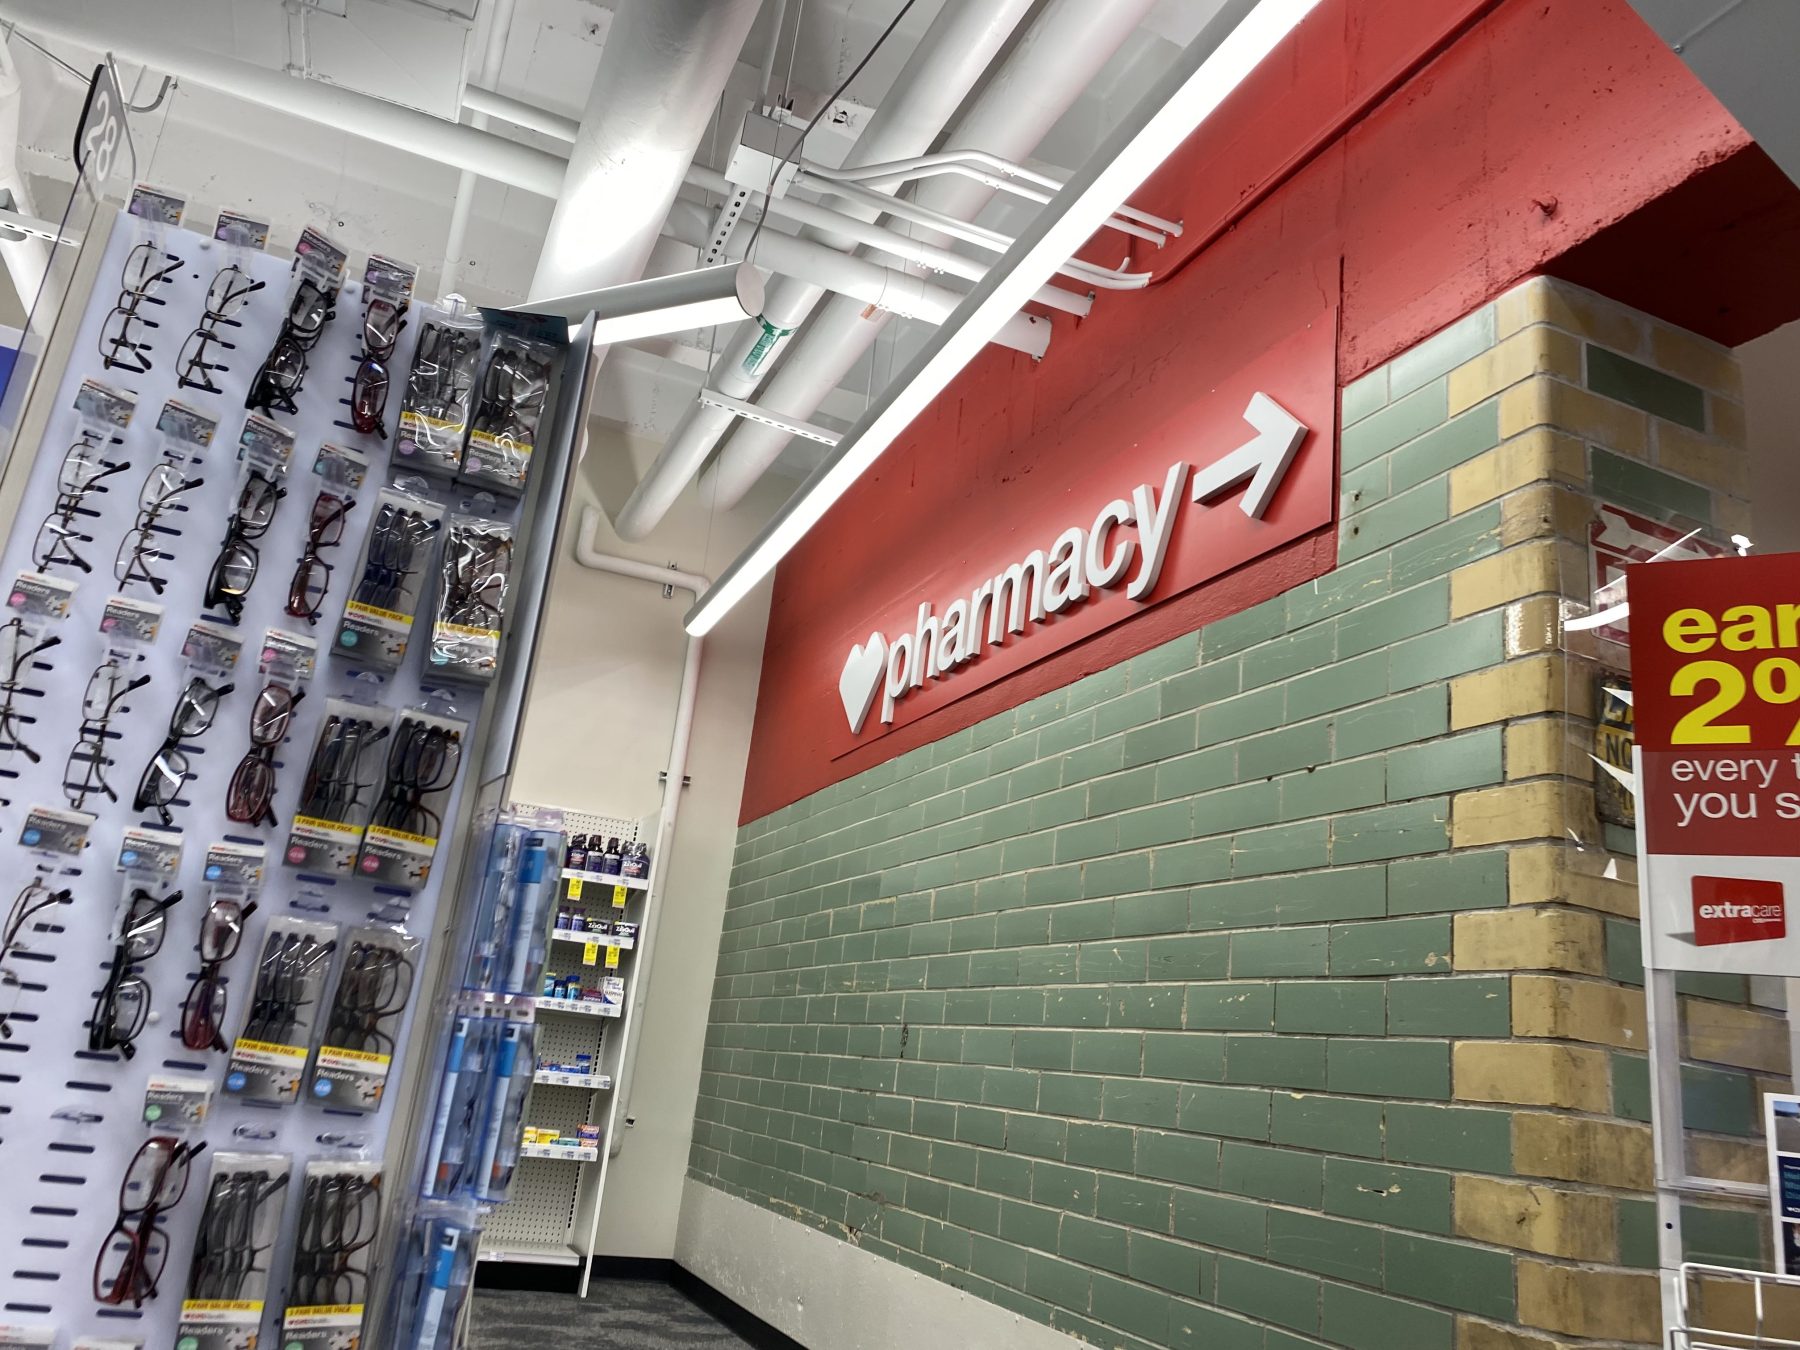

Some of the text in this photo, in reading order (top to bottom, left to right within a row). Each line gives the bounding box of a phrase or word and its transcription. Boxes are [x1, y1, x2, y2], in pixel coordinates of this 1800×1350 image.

[85, 90, 117, 182] 28
[880, 460, 1193, 726] pharmacy
[344, 620, 379, 636] Readers
[1671, 758, 1779, 788] every
[1673, 792, 1758, 827] you
[291, 836, 328, 850] Readers
[365, 845, 401, 860] Readers
[1699, 902, 1781, 918] extracare
[230, 1062, 270, 1076] Readers
[316, 1068, 354, 1081] Readers
[180, 1324, 224, 1336] Readers
[284, 1328, 327, 1340] Readers
